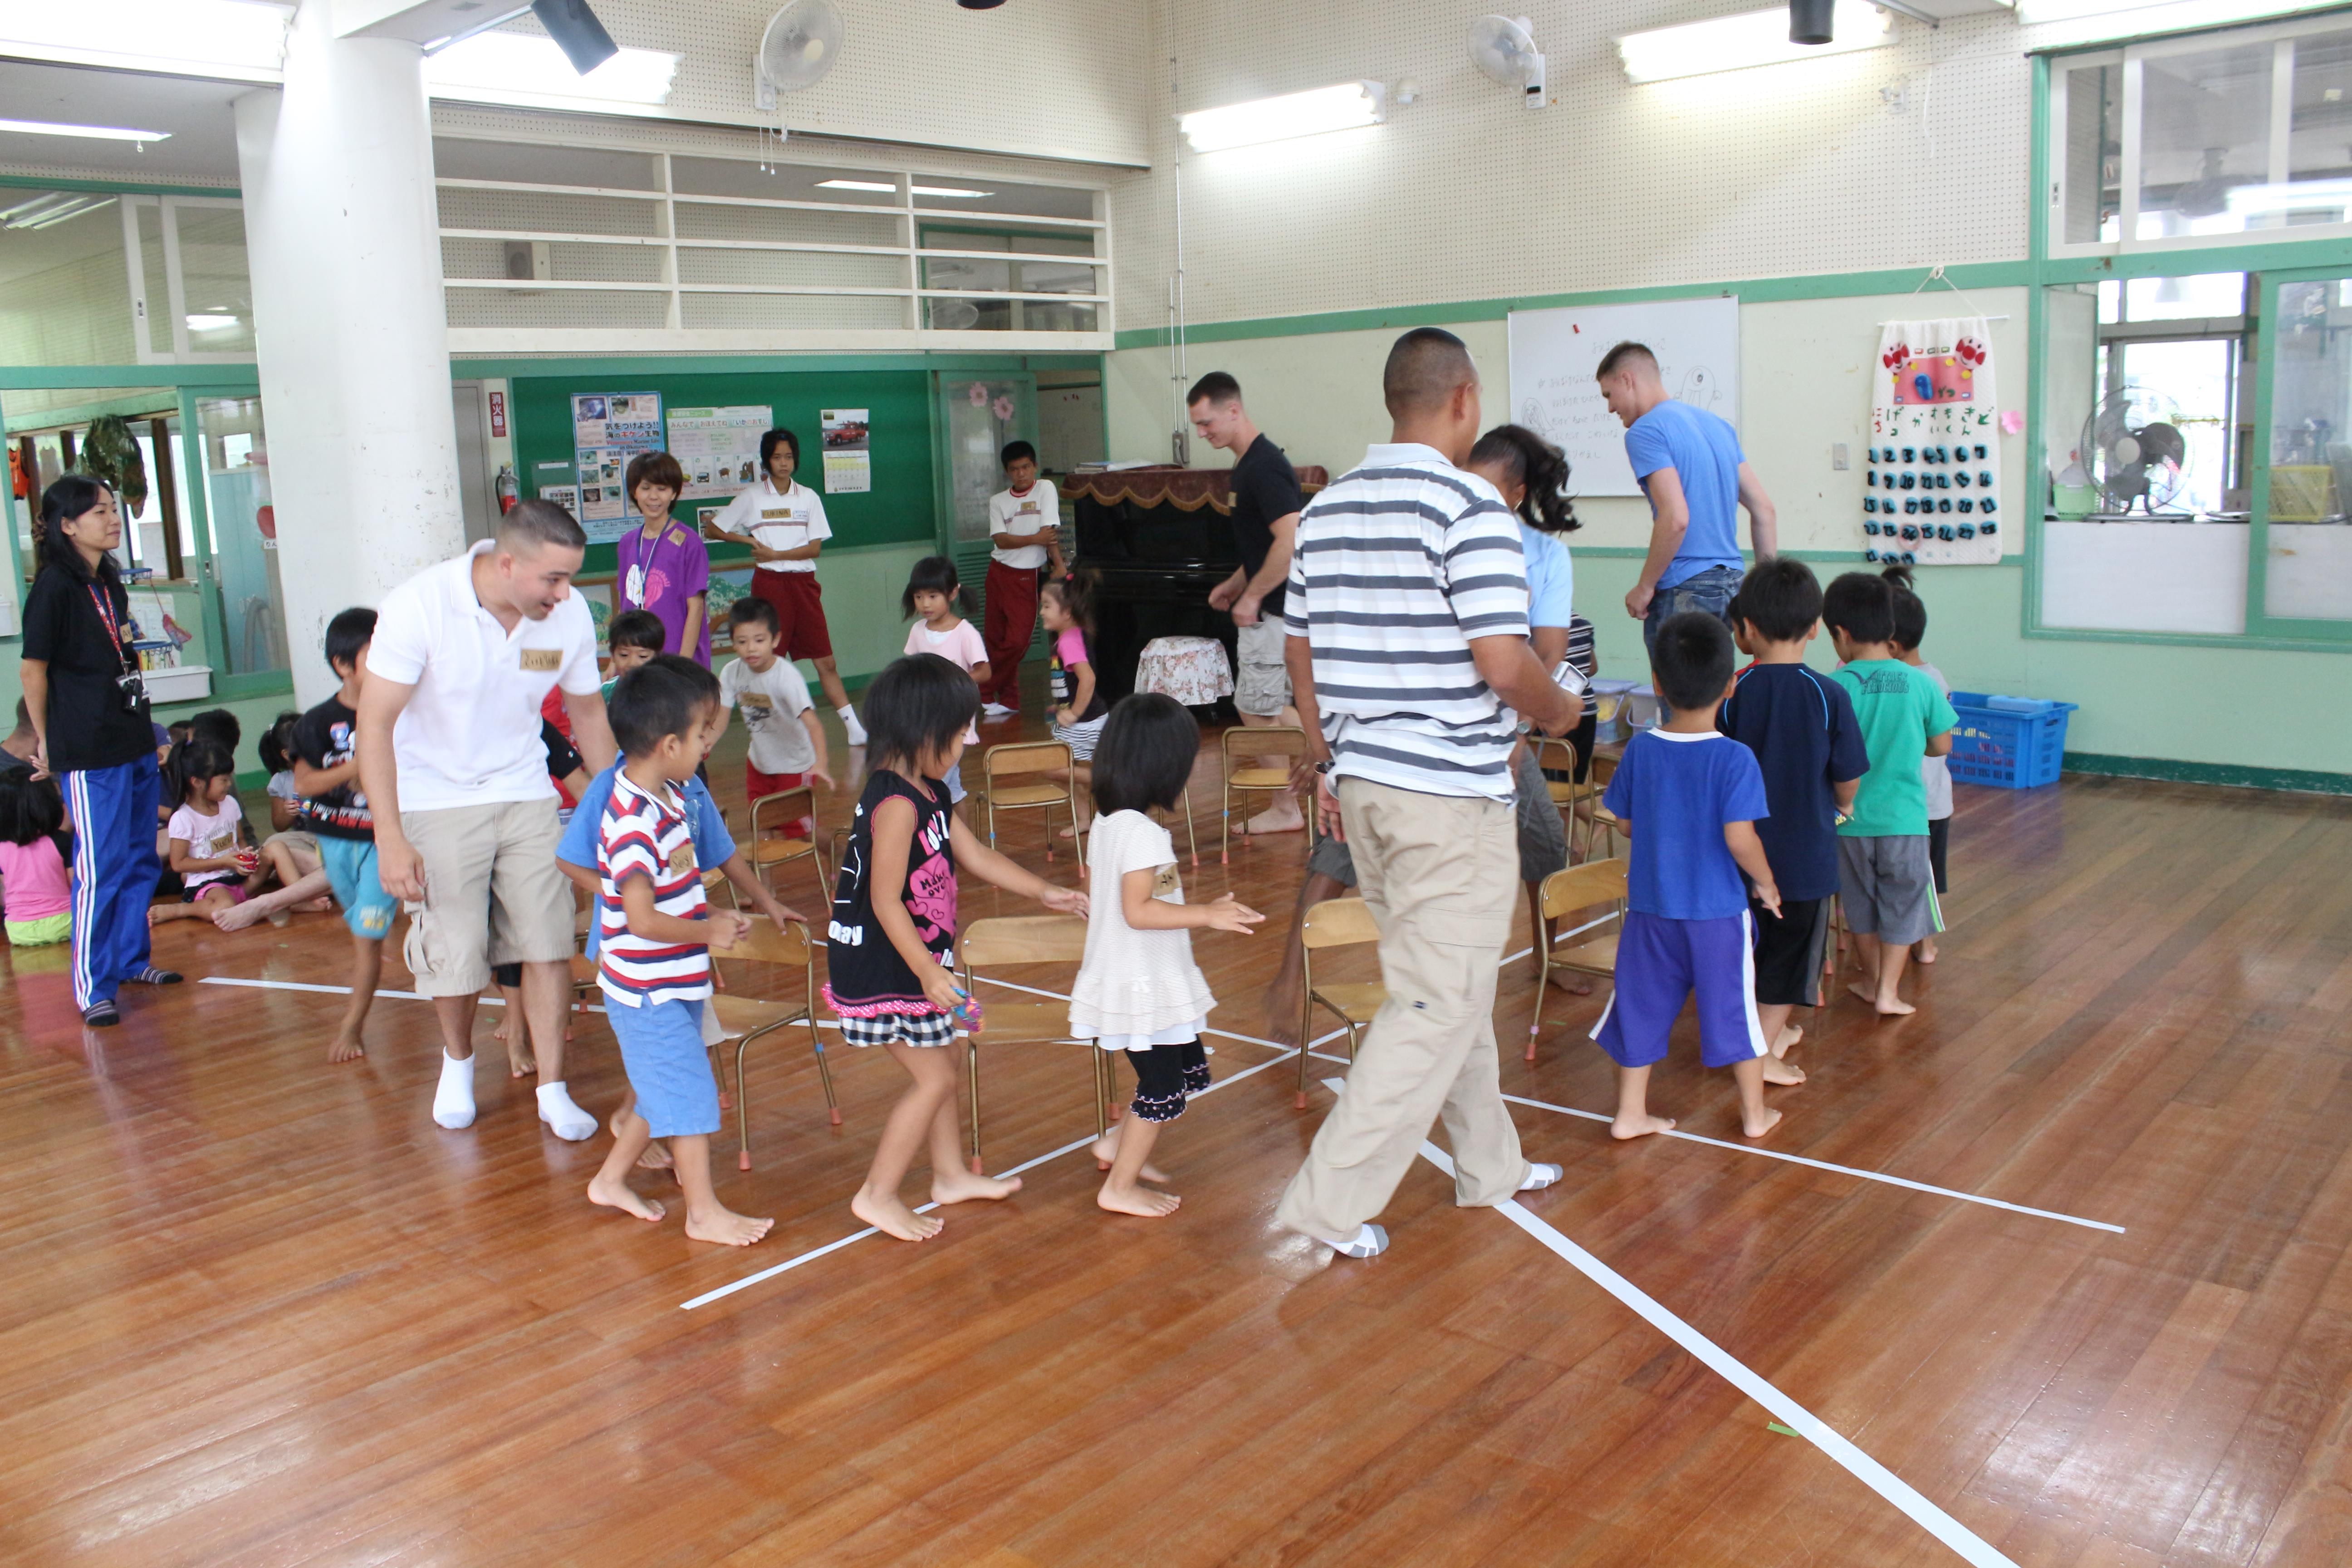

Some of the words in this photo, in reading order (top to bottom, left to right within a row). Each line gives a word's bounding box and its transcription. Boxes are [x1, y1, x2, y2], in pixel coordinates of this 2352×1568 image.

[491, 394, 504, 426] 消火器
[1868, 449, 1878, 463] 1
[1884, 450, 1896, 462] 2
[1902, 449, 1914, 463] 3
[1955, 447, 1967, 462] 6
[1975, 446, 1985, 459] 7
